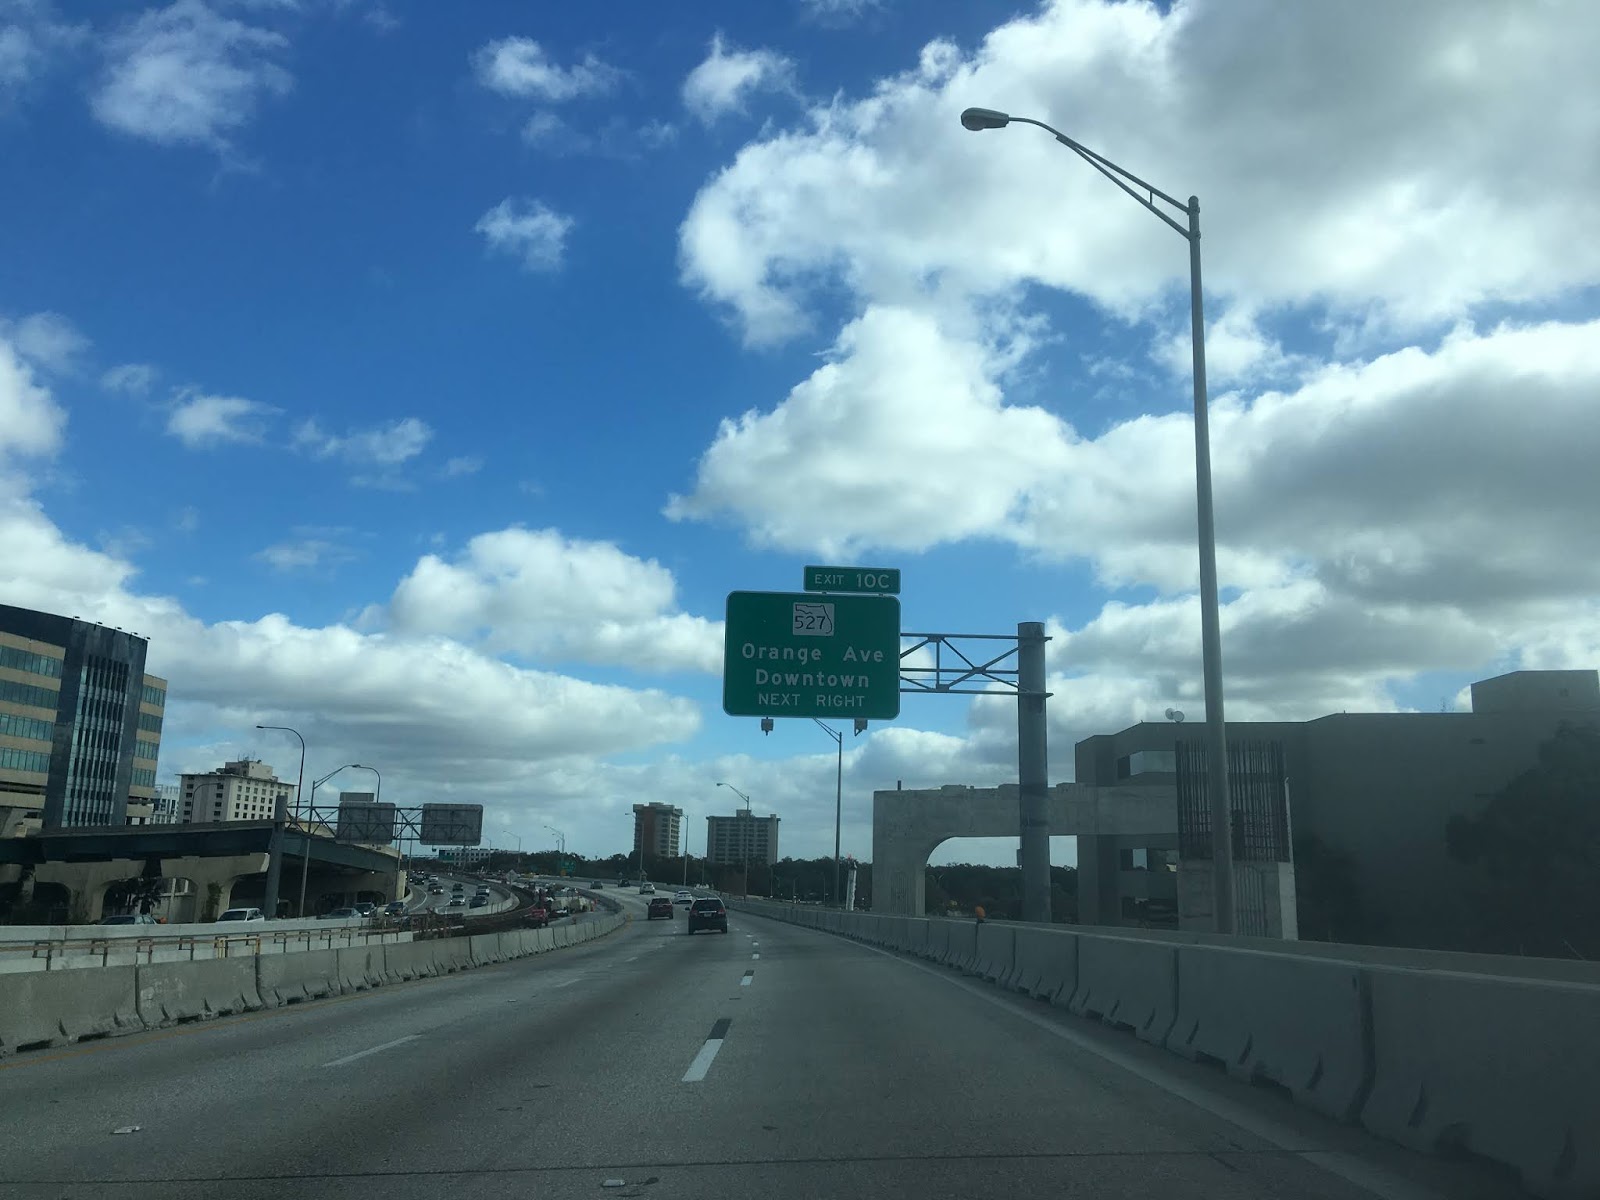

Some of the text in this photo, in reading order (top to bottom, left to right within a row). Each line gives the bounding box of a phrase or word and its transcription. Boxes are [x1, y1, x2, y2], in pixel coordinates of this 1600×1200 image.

[814, 573, 890, 589] EXIT 10C
[794, 615, 826, 630] 527
[742, 642, 885, 665] Orange Ave
[755, 668, 870, 688] Downtown
[758, 693, 865, 707] NEXT RIGHT
